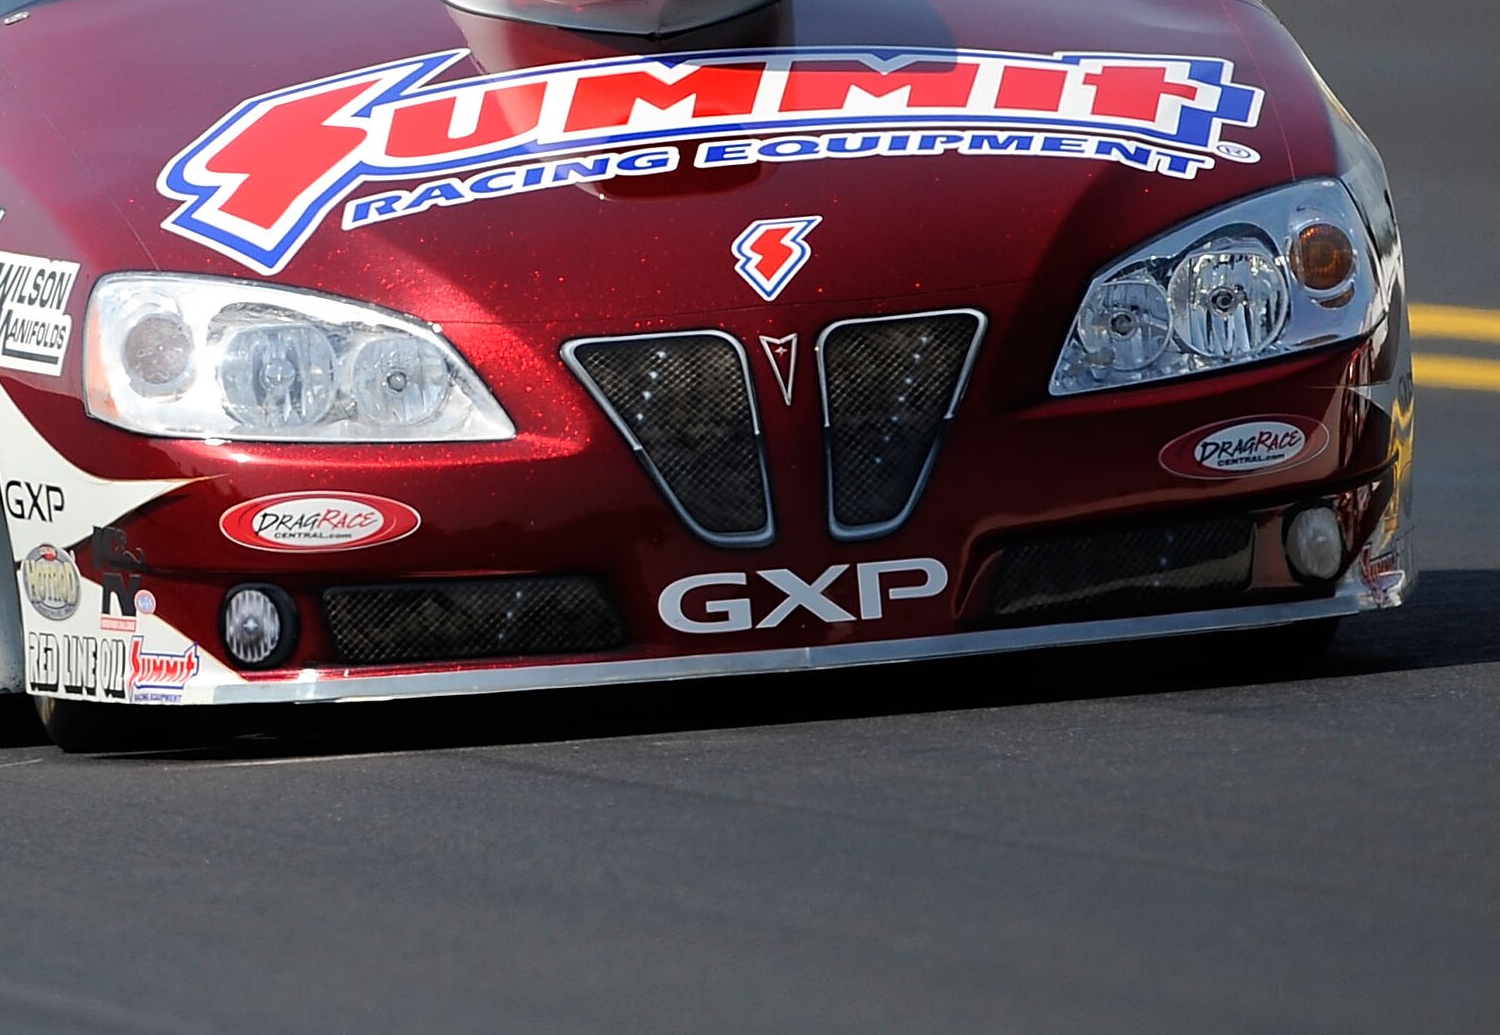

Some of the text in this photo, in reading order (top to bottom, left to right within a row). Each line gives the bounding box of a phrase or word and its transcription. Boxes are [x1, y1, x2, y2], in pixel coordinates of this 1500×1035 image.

[200, 61, 1200, 232] SUMMIT
[351, 150, 671, 227] RACING
[703, 134, 1206, 174] EQUIPMENT
[4, 479, 65, 523] GXP
[658, 556, 948, 634] GXP
[28, 632, 59, 692] RED
[63, 635, 98, 696] LINE
[100, 638, 126, 699] OIL
[129, 638, 198, 692] SUMMIT
